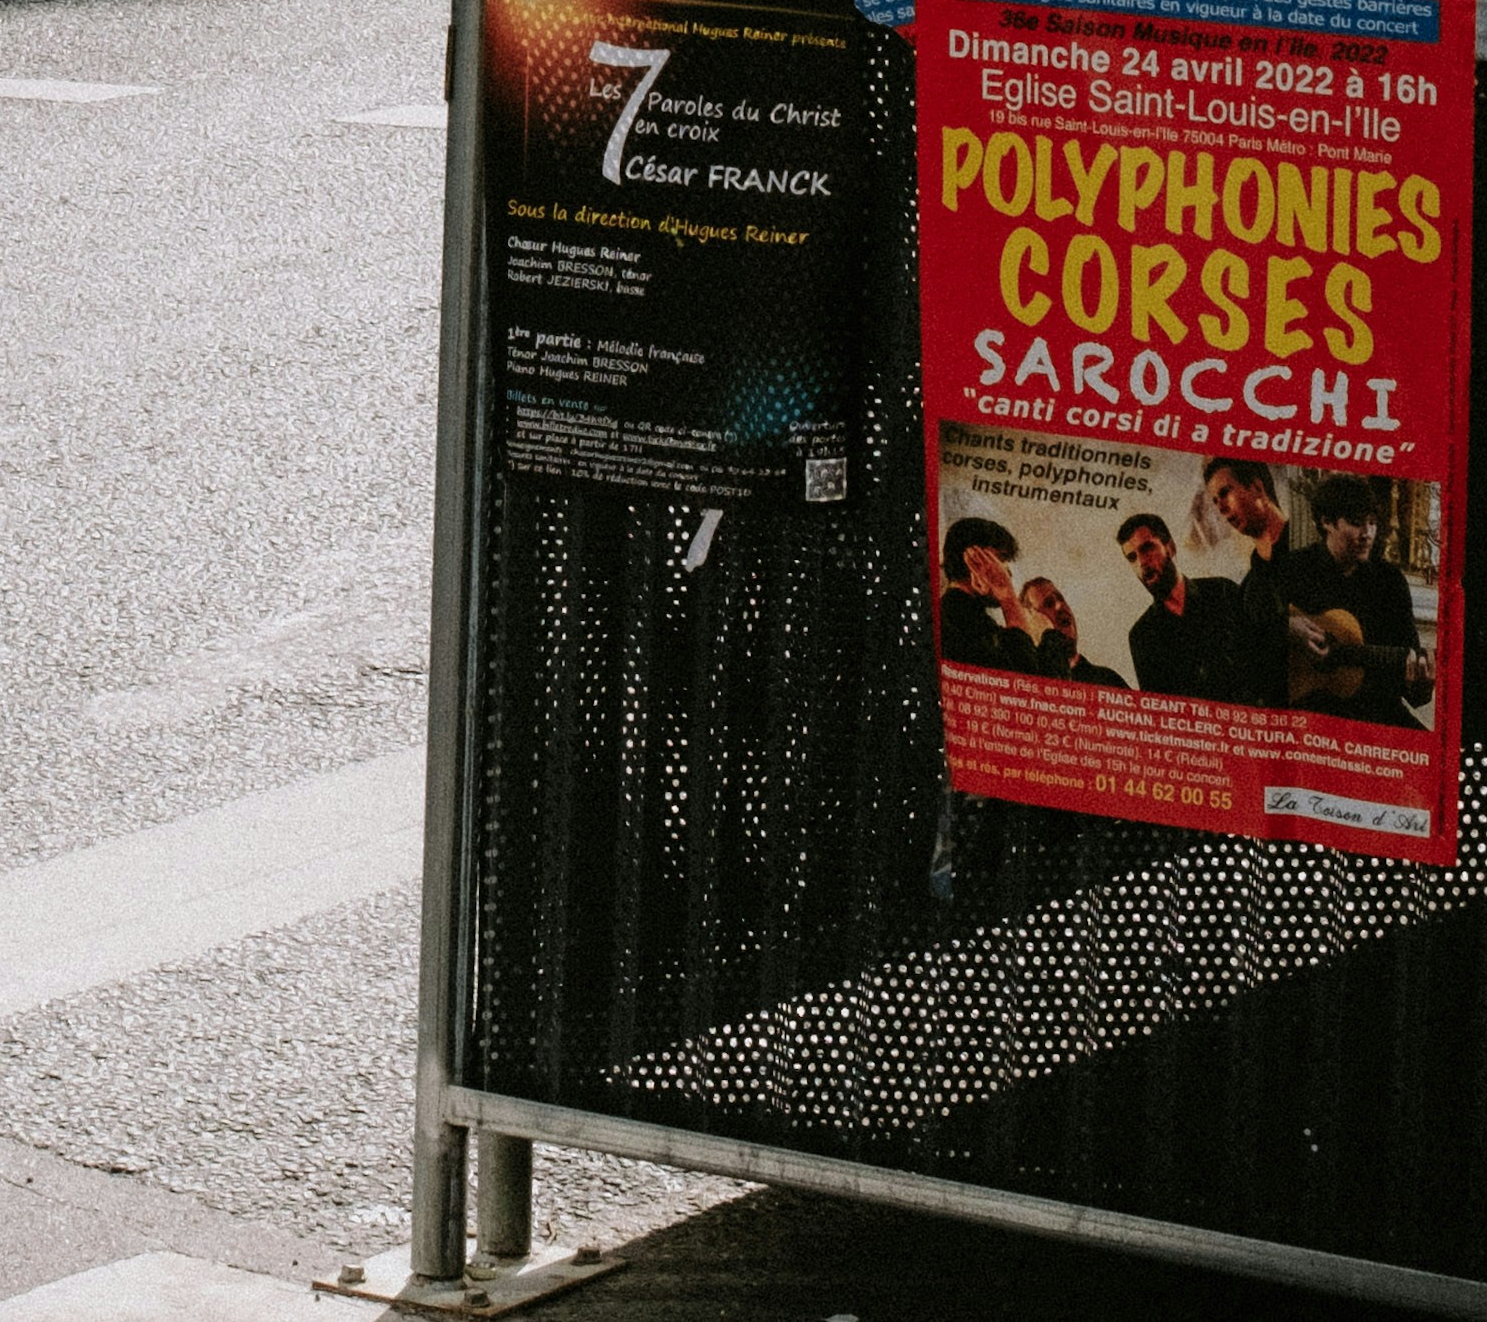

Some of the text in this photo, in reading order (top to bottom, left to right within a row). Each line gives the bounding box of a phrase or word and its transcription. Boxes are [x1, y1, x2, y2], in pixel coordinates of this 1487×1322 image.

[589, 78, 622, 99] Les
[949, 29, 1437, 106] Dimanche 24 avril 2022 à 16h
[981, 68, 1077, 111] Eglise
[589, 40, 670, 186] 7
[635, 120, 720, 142] en croix
[648, 92, 841, 127] Paroles du Christ
[625, 156, 831, 195] César FRANCK
[942, 126, 1441, 263] POLYPHONIES
[508, 200, 810, 245] Sous la direction d'Hugues Reiner
[999, 226, 1374, 365] CORSES
[973, 329, 1401, 431] SAROCCHI
[1065, 407, 1142, 433] corsi
[1154, 413, 1180, 440] di
[1192, 423, 1209, 443] a
